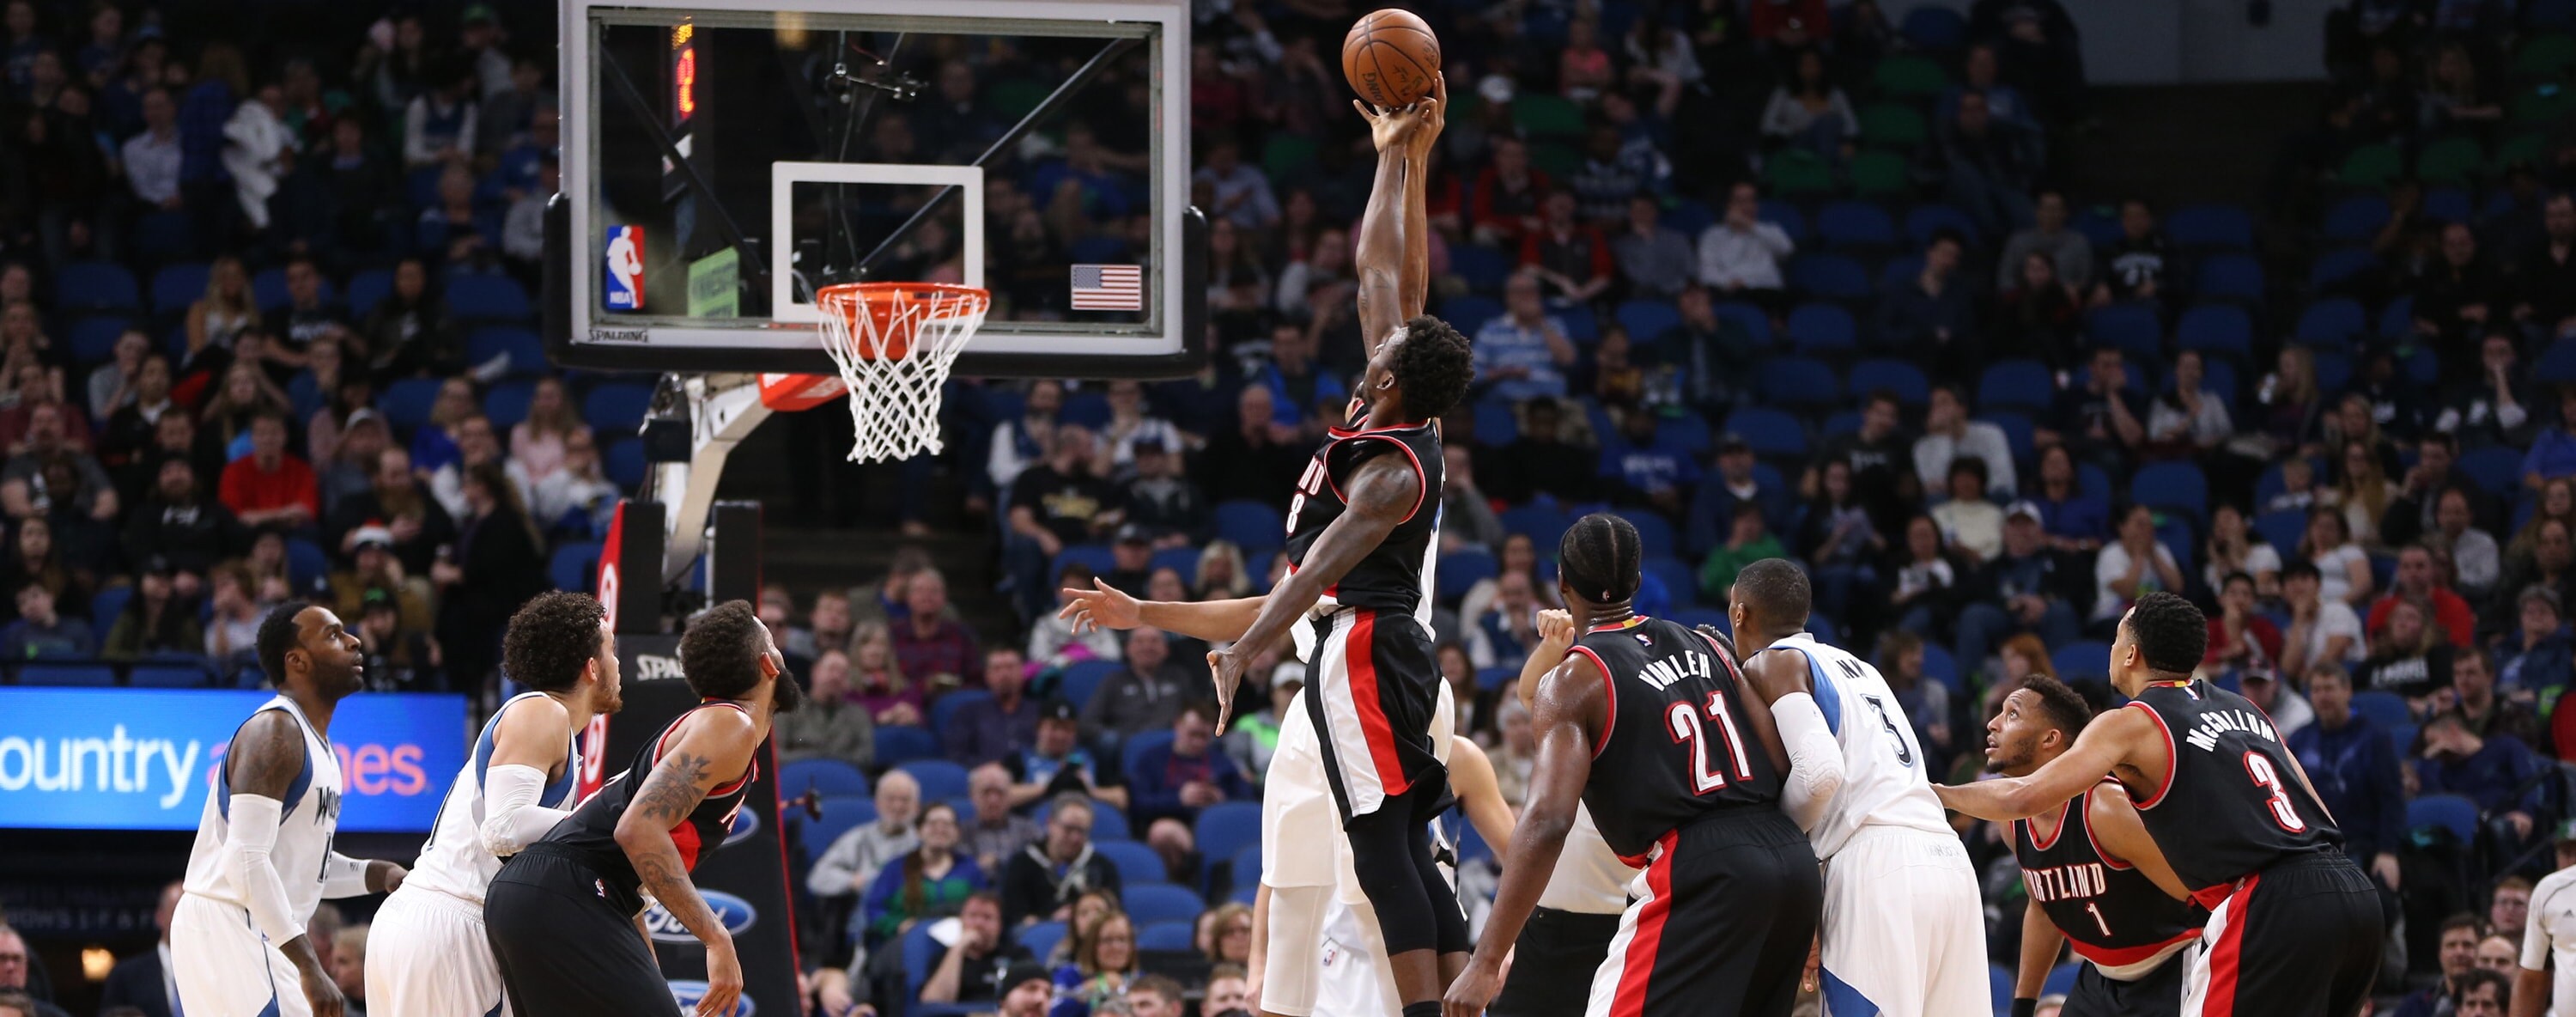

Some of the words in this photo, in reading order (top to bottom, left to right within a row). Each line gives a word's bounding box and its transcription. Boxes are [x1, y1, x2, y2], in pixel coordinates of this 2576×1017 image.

[611, 291, 631, 304] NBA
[589, 329, 647, 343] SPALDING
[1286, 491, 1305, 535] 8
[1638, 649, 1711, 691] VONLEH
[1663, 690, 1753, 797] 21
[1859, 692, 1914, 768] 3
[2186, 709, 2275, 752] McCOLLUM
[2242, 750, 2307, 833] 3
[2086, 902, 2111, 937] 1
